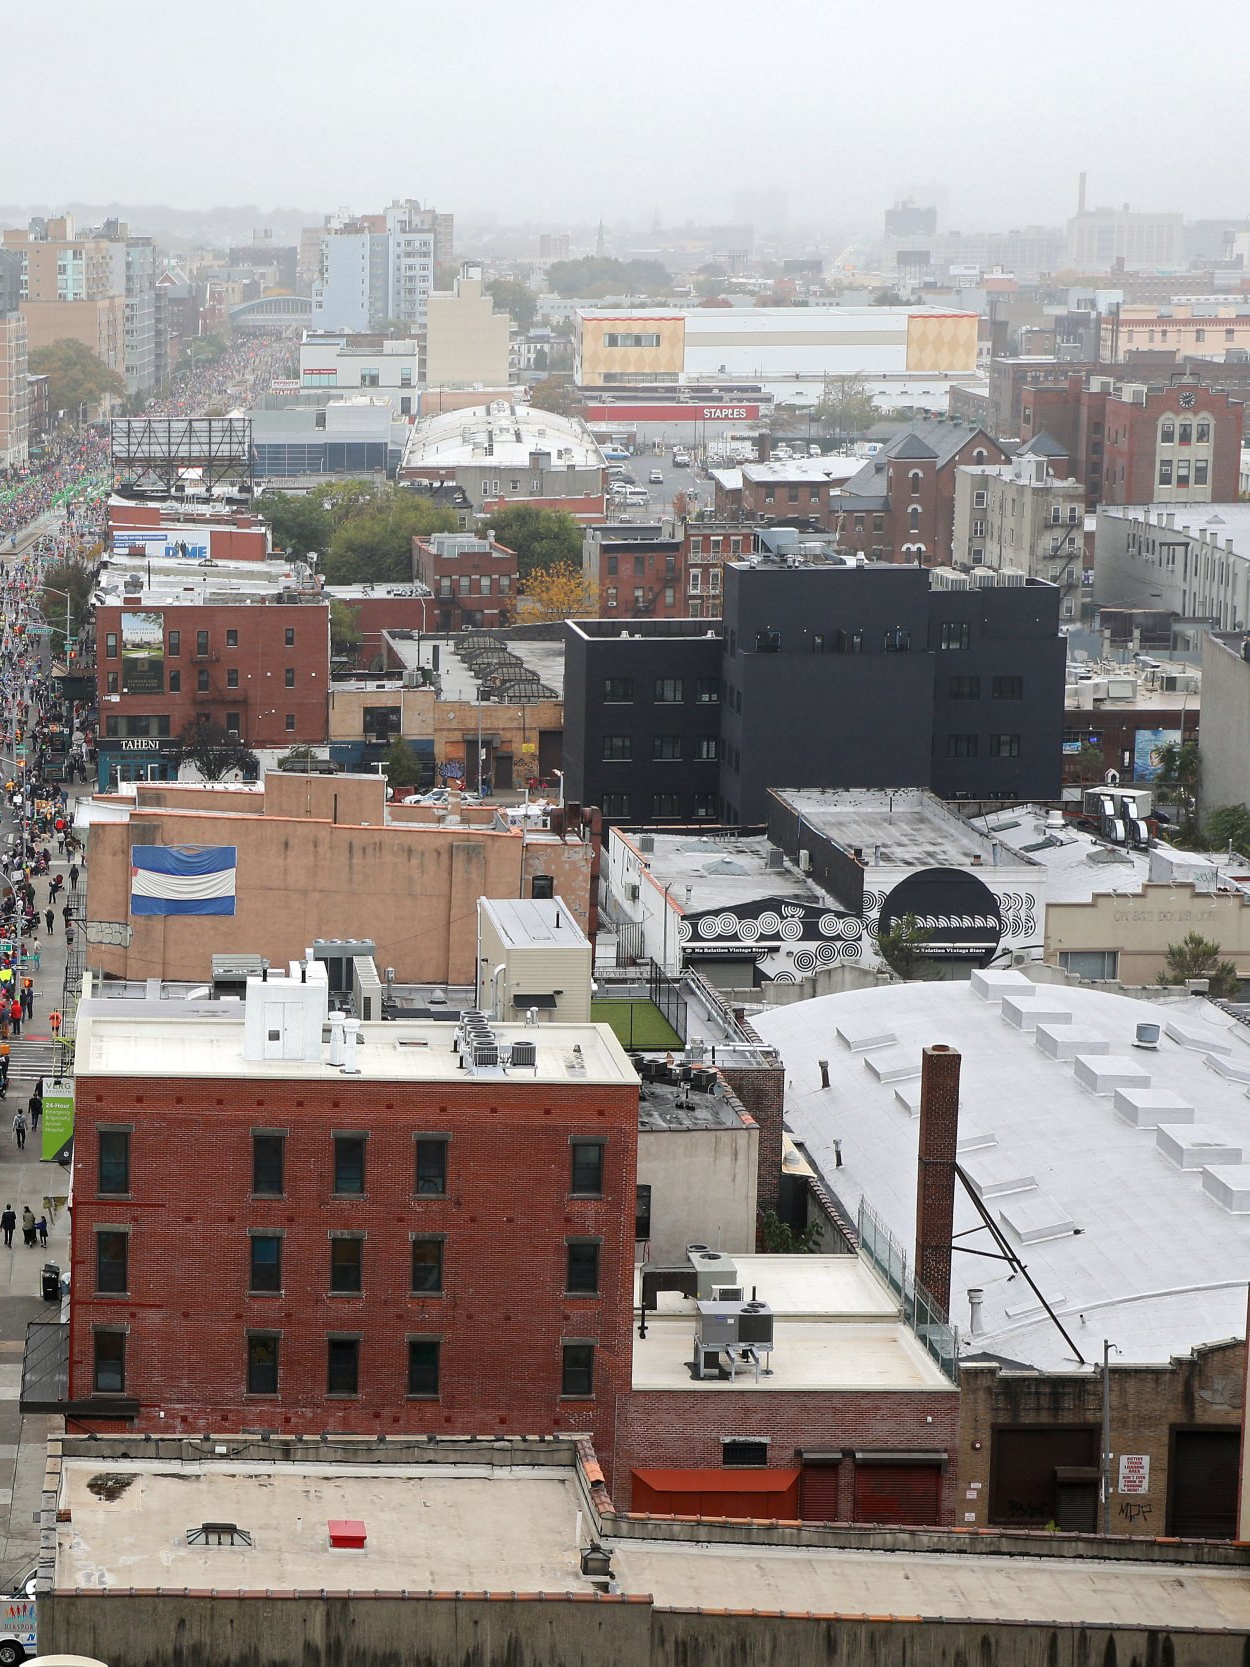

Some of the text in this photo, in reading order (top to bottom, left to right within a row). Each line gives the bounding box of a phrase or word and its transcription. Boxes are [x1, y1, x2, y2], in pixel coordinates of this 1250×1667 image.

[703, 408, 747, 419] STAPLES
[164, 546, 207, 558] DME
[121, 740, 160, 749] TAHENI
